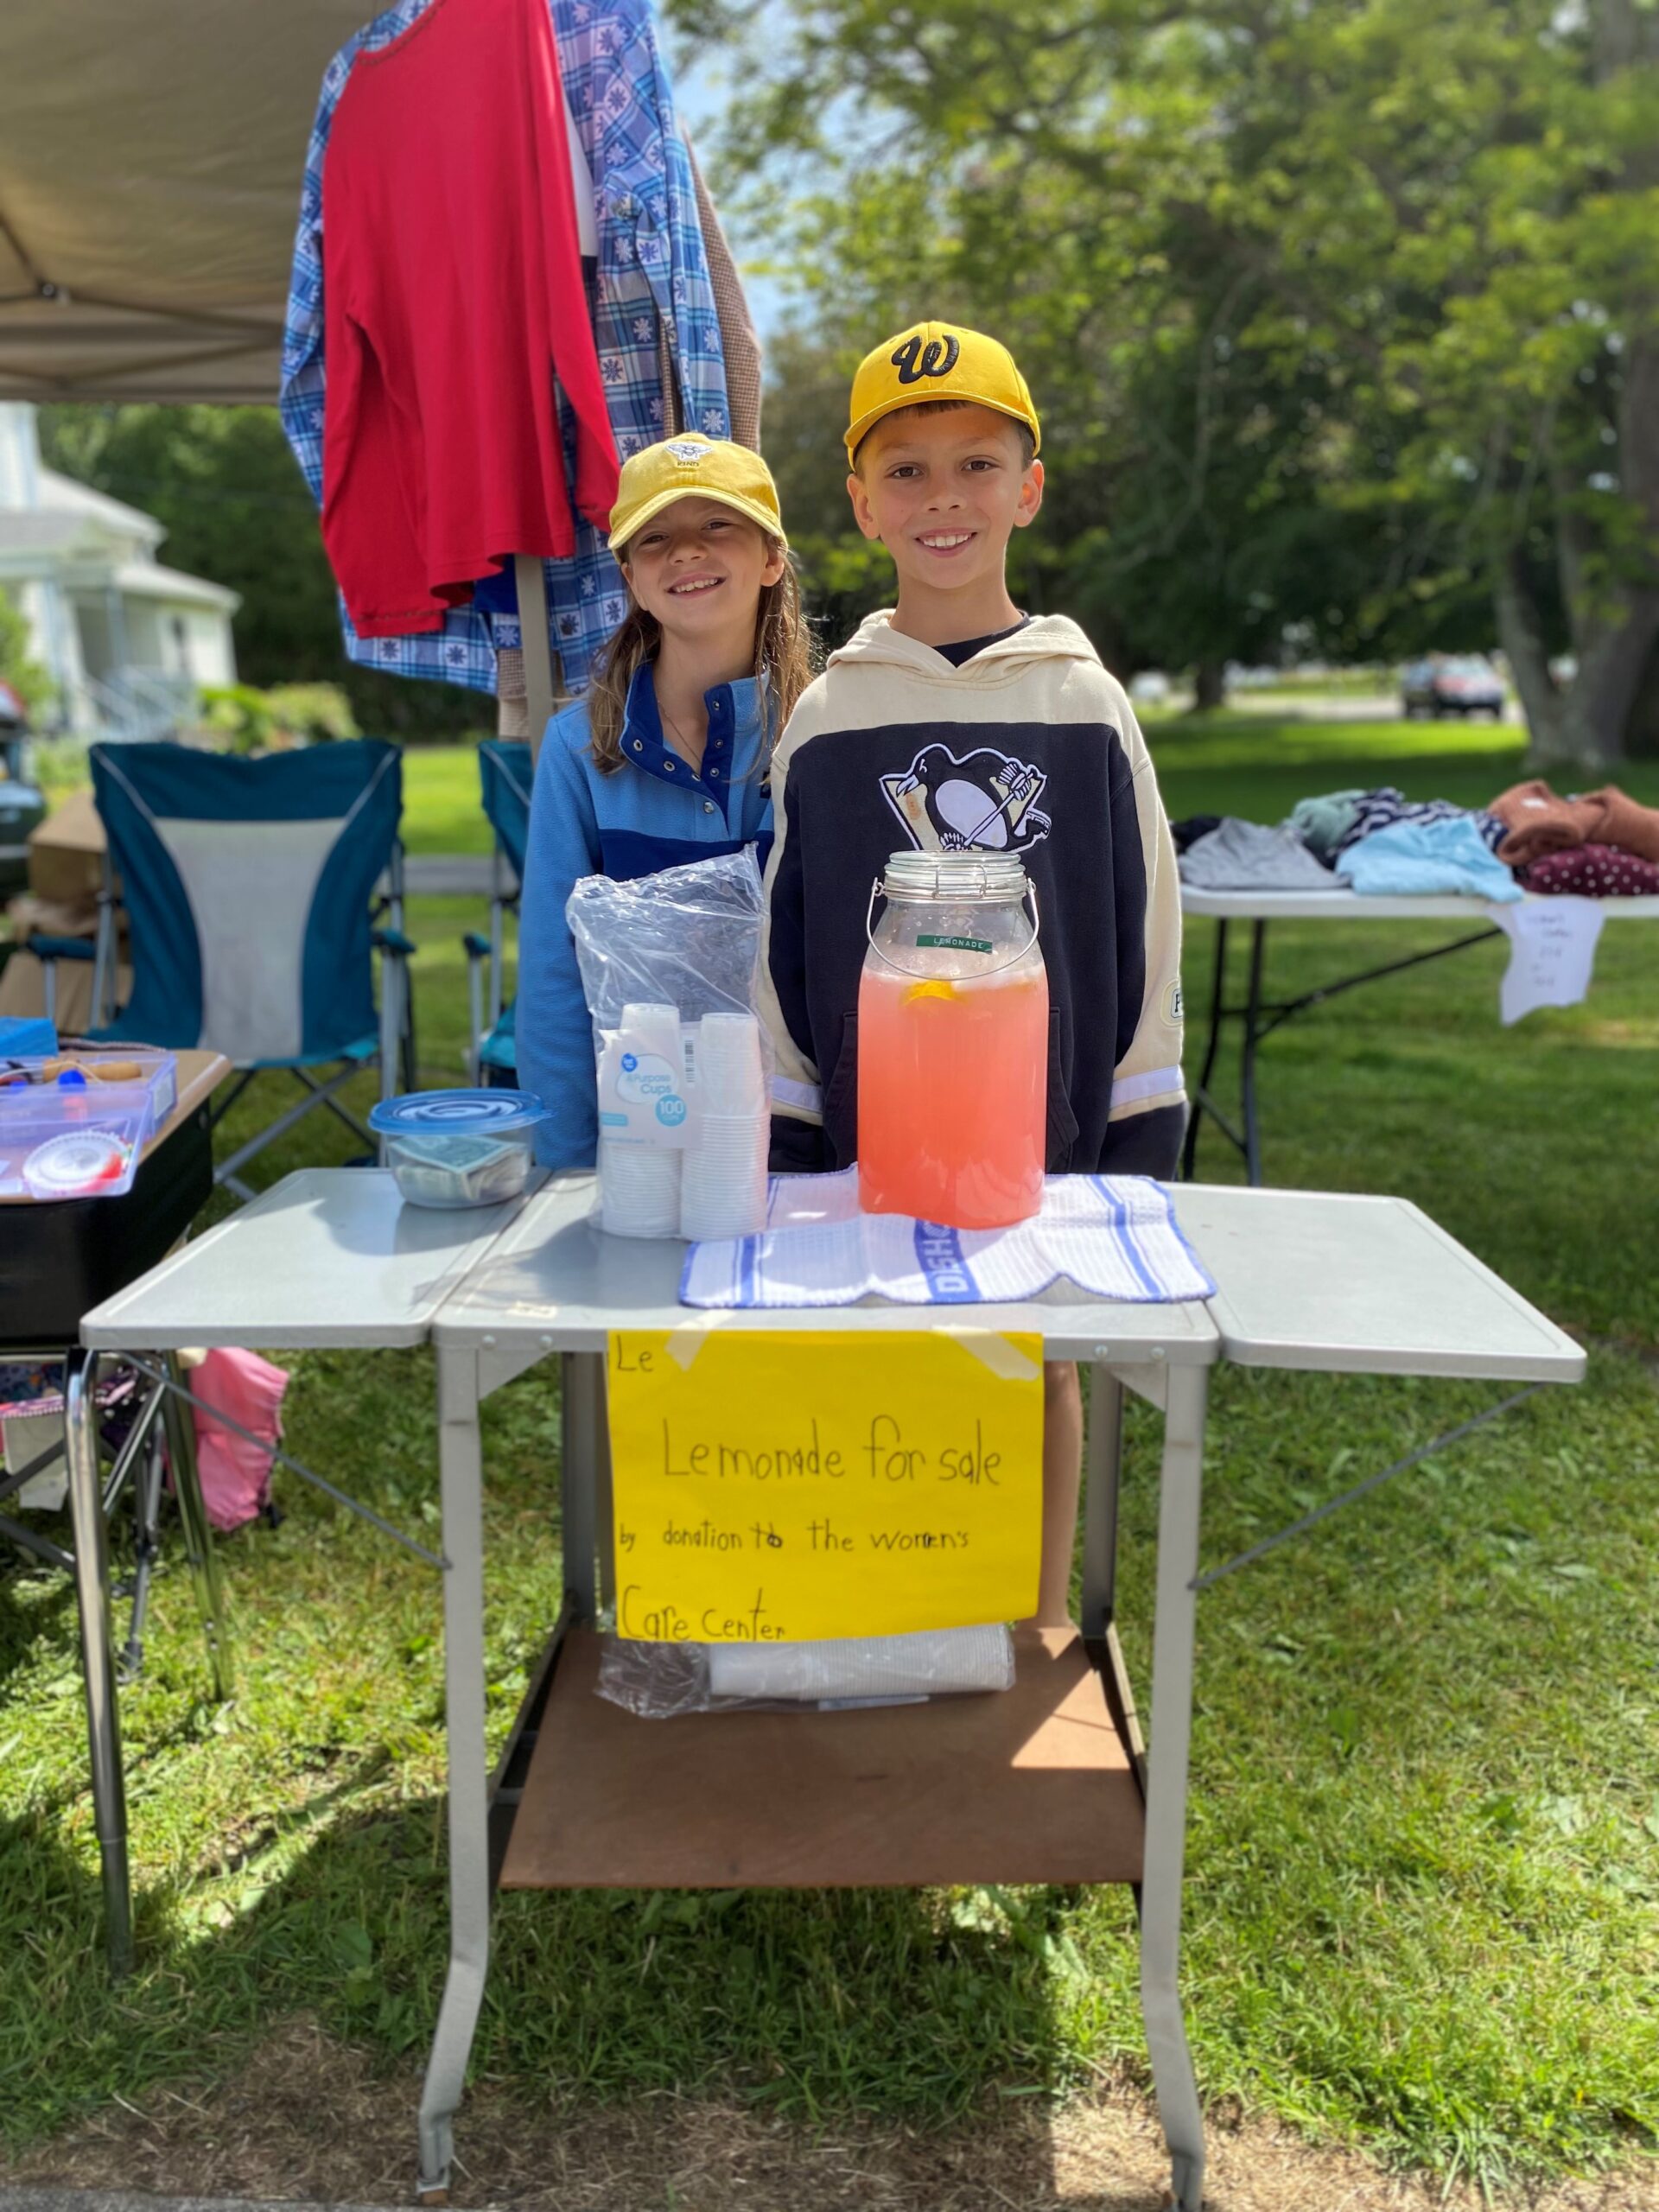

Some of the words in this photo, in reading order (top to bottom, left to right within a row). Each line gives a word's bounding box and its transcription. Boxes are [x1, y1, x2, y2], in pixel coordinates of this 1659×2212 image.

[892, 335, 960, 385] W
[933, 937, 984, 949] LEMONADE
[641, 1084, 671, 1096] Cups
[659, 1101, 683, 1115] 100
[616, 1335, 654, 1372] Le
[663, 1417, 846, 1480] Lemonade
[863, 1414, 926, 1482] for
[938, 1419, 1002, 1486] sale
[619, 1522, 636, 1553] by
[663, 1519, 743, 1551] donation
[806, 1517, 855, 1552] the
[622, 1584, 691, 1641] Care
